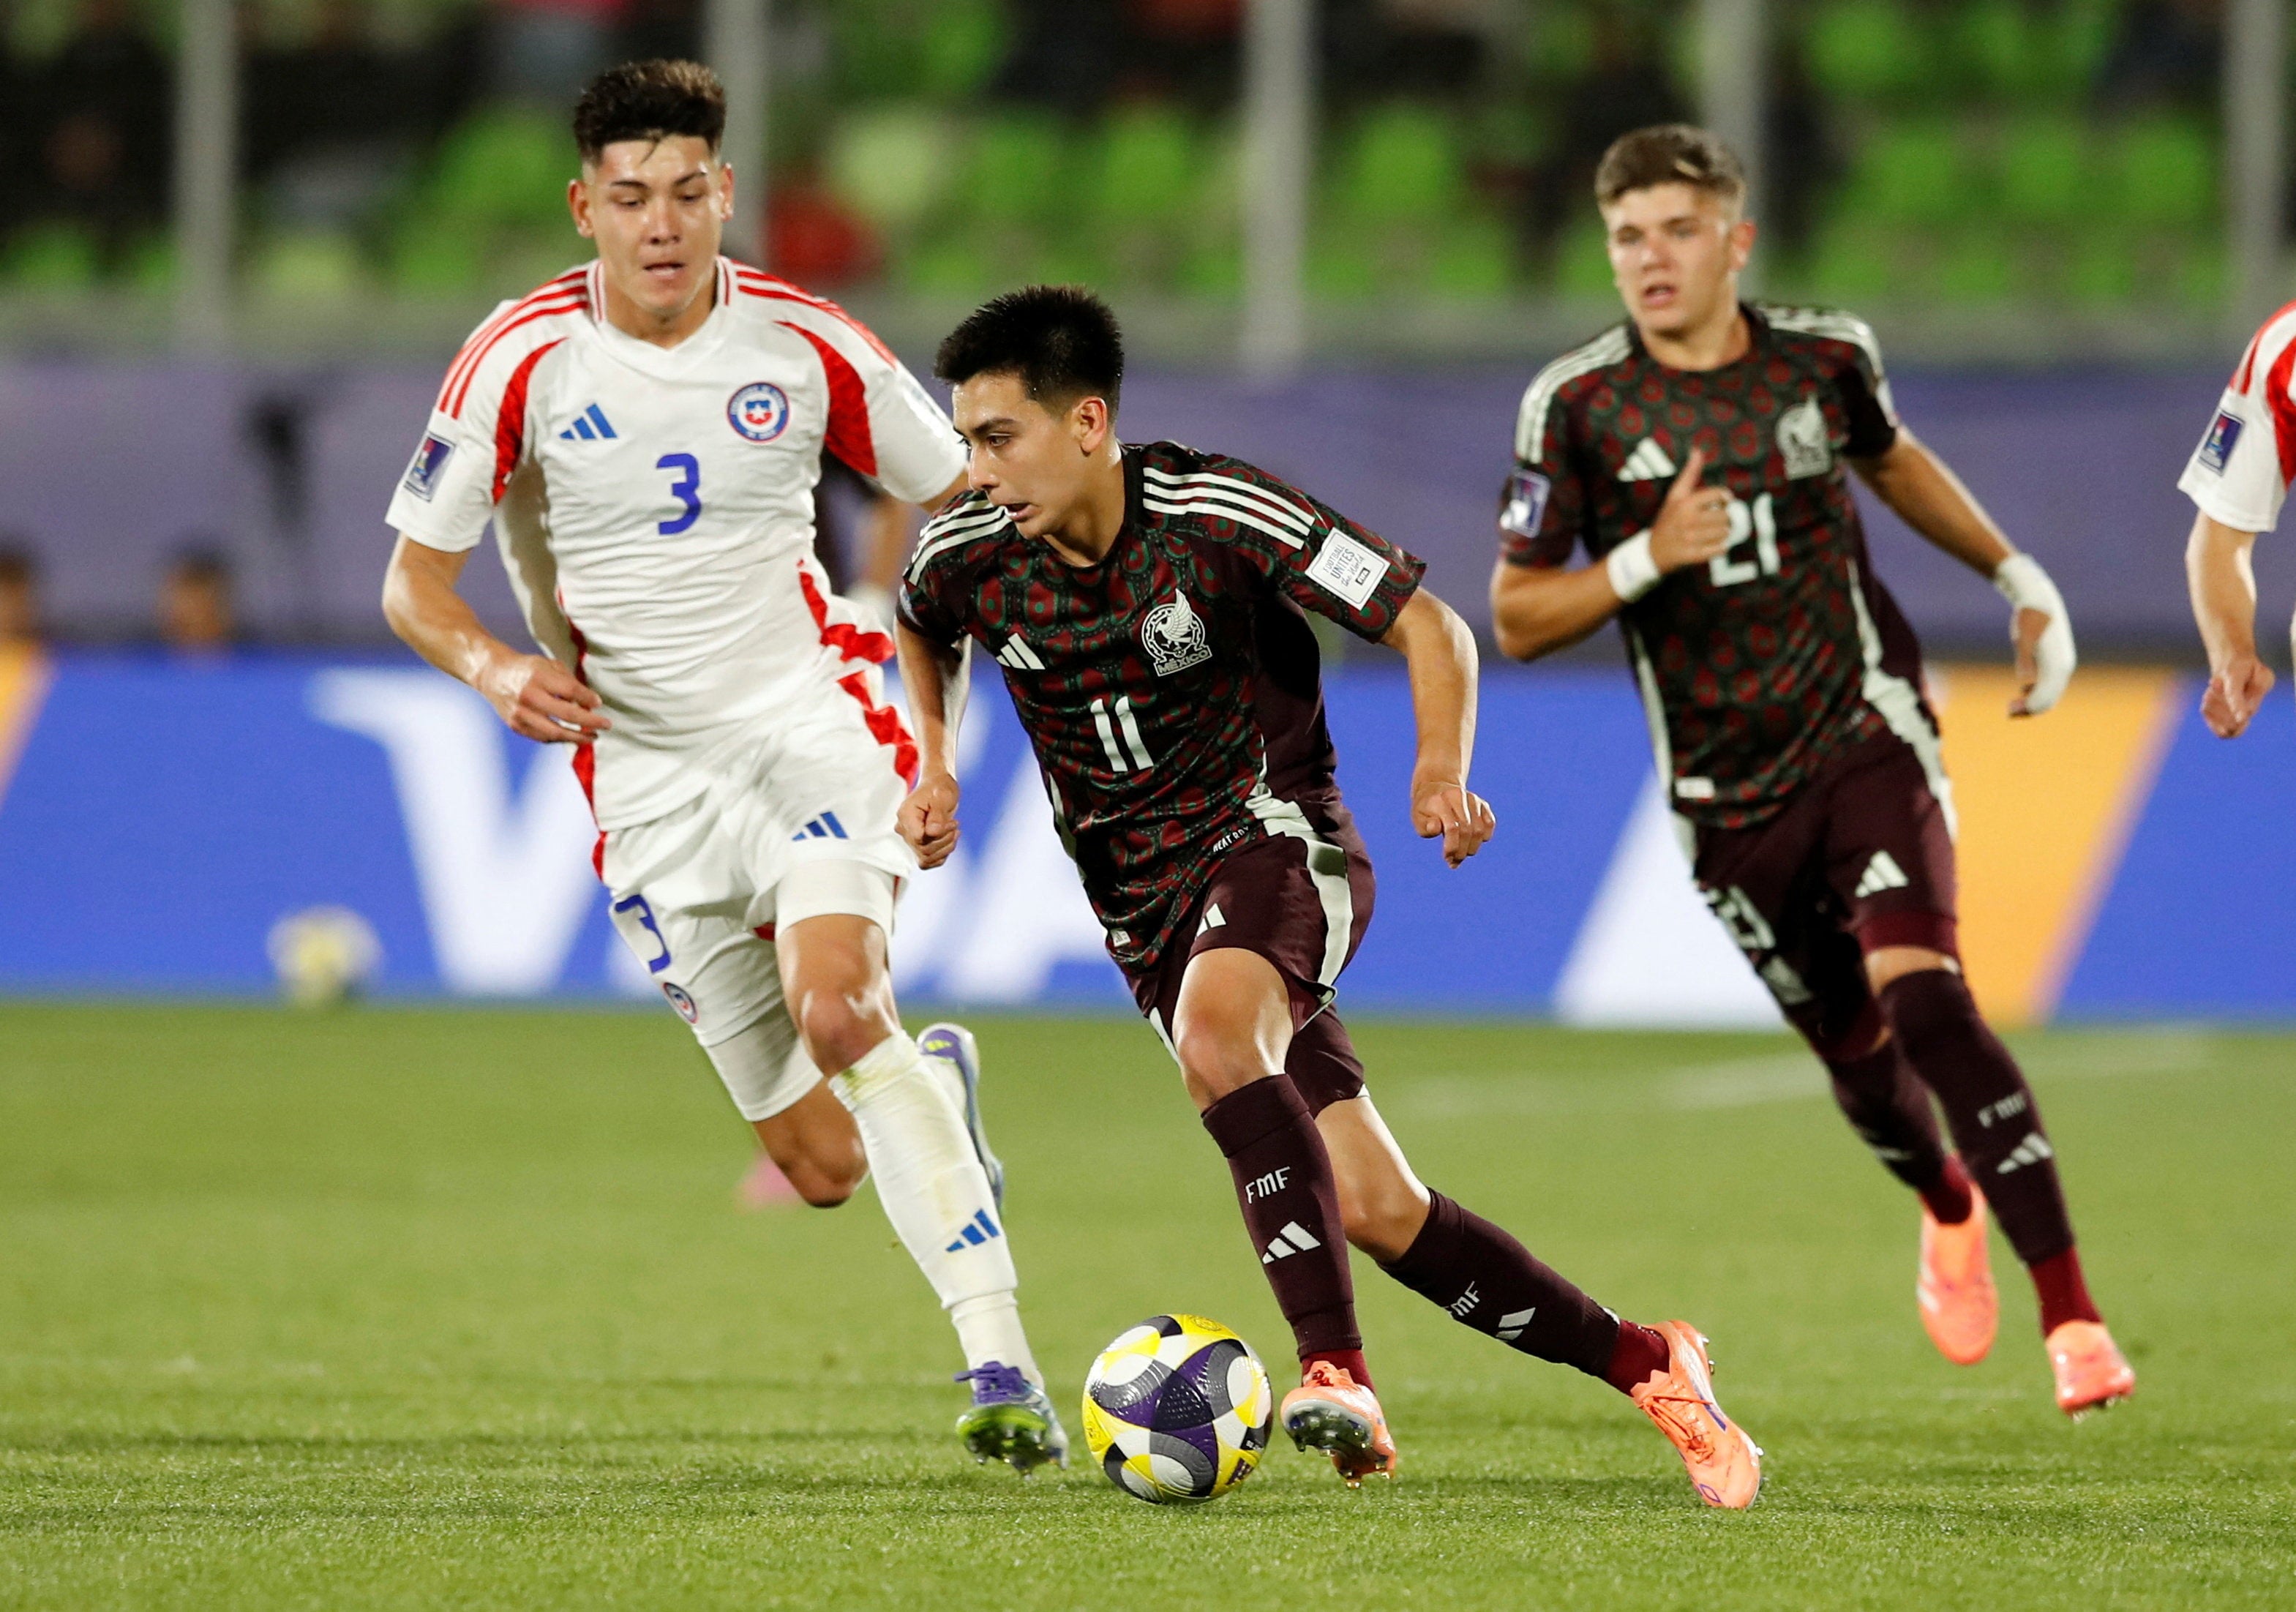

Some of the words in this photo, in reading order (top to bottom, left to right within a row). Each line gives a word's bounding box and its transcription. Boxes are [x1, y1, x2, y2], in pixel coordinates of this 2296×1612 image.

[656, 452, 702, 535] 3
[1323, 544, 1345, 573] FOOTBALL
[1330, 549, 1355, 579] UNITES
[1708, 492, 1780, 588] 21
[1090, 695, 1155, 772] 11
[309, 666, 1163, 1001] VA
[615, 893, 671, 974] 3
[1245, 1166, 1291, 1204] FMF
